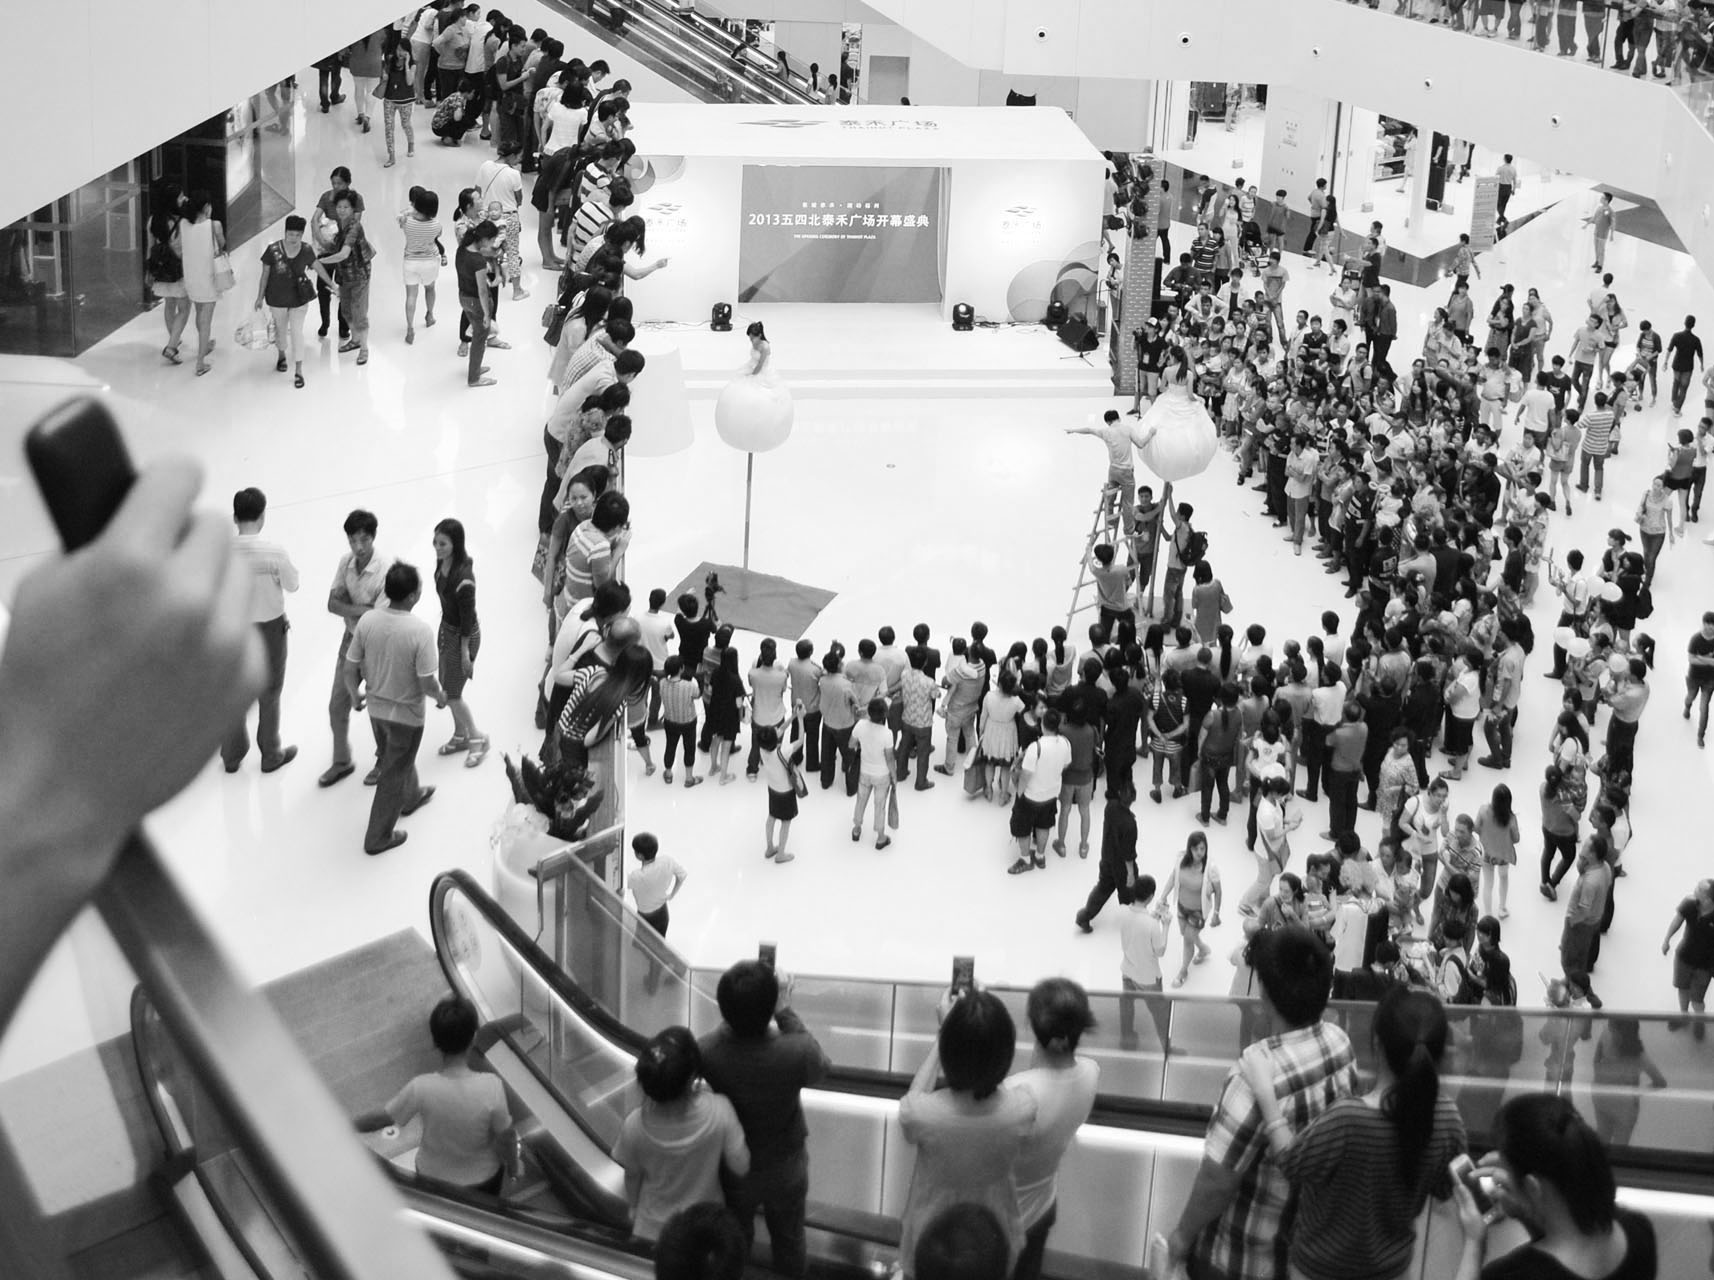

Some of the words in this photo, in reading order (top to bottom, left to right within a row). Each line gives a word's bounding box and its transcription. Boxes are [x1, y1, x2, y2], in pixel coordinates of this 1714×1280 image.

[748, 213, 930, 228] 2013五四北泰禾广场开幕盛典
